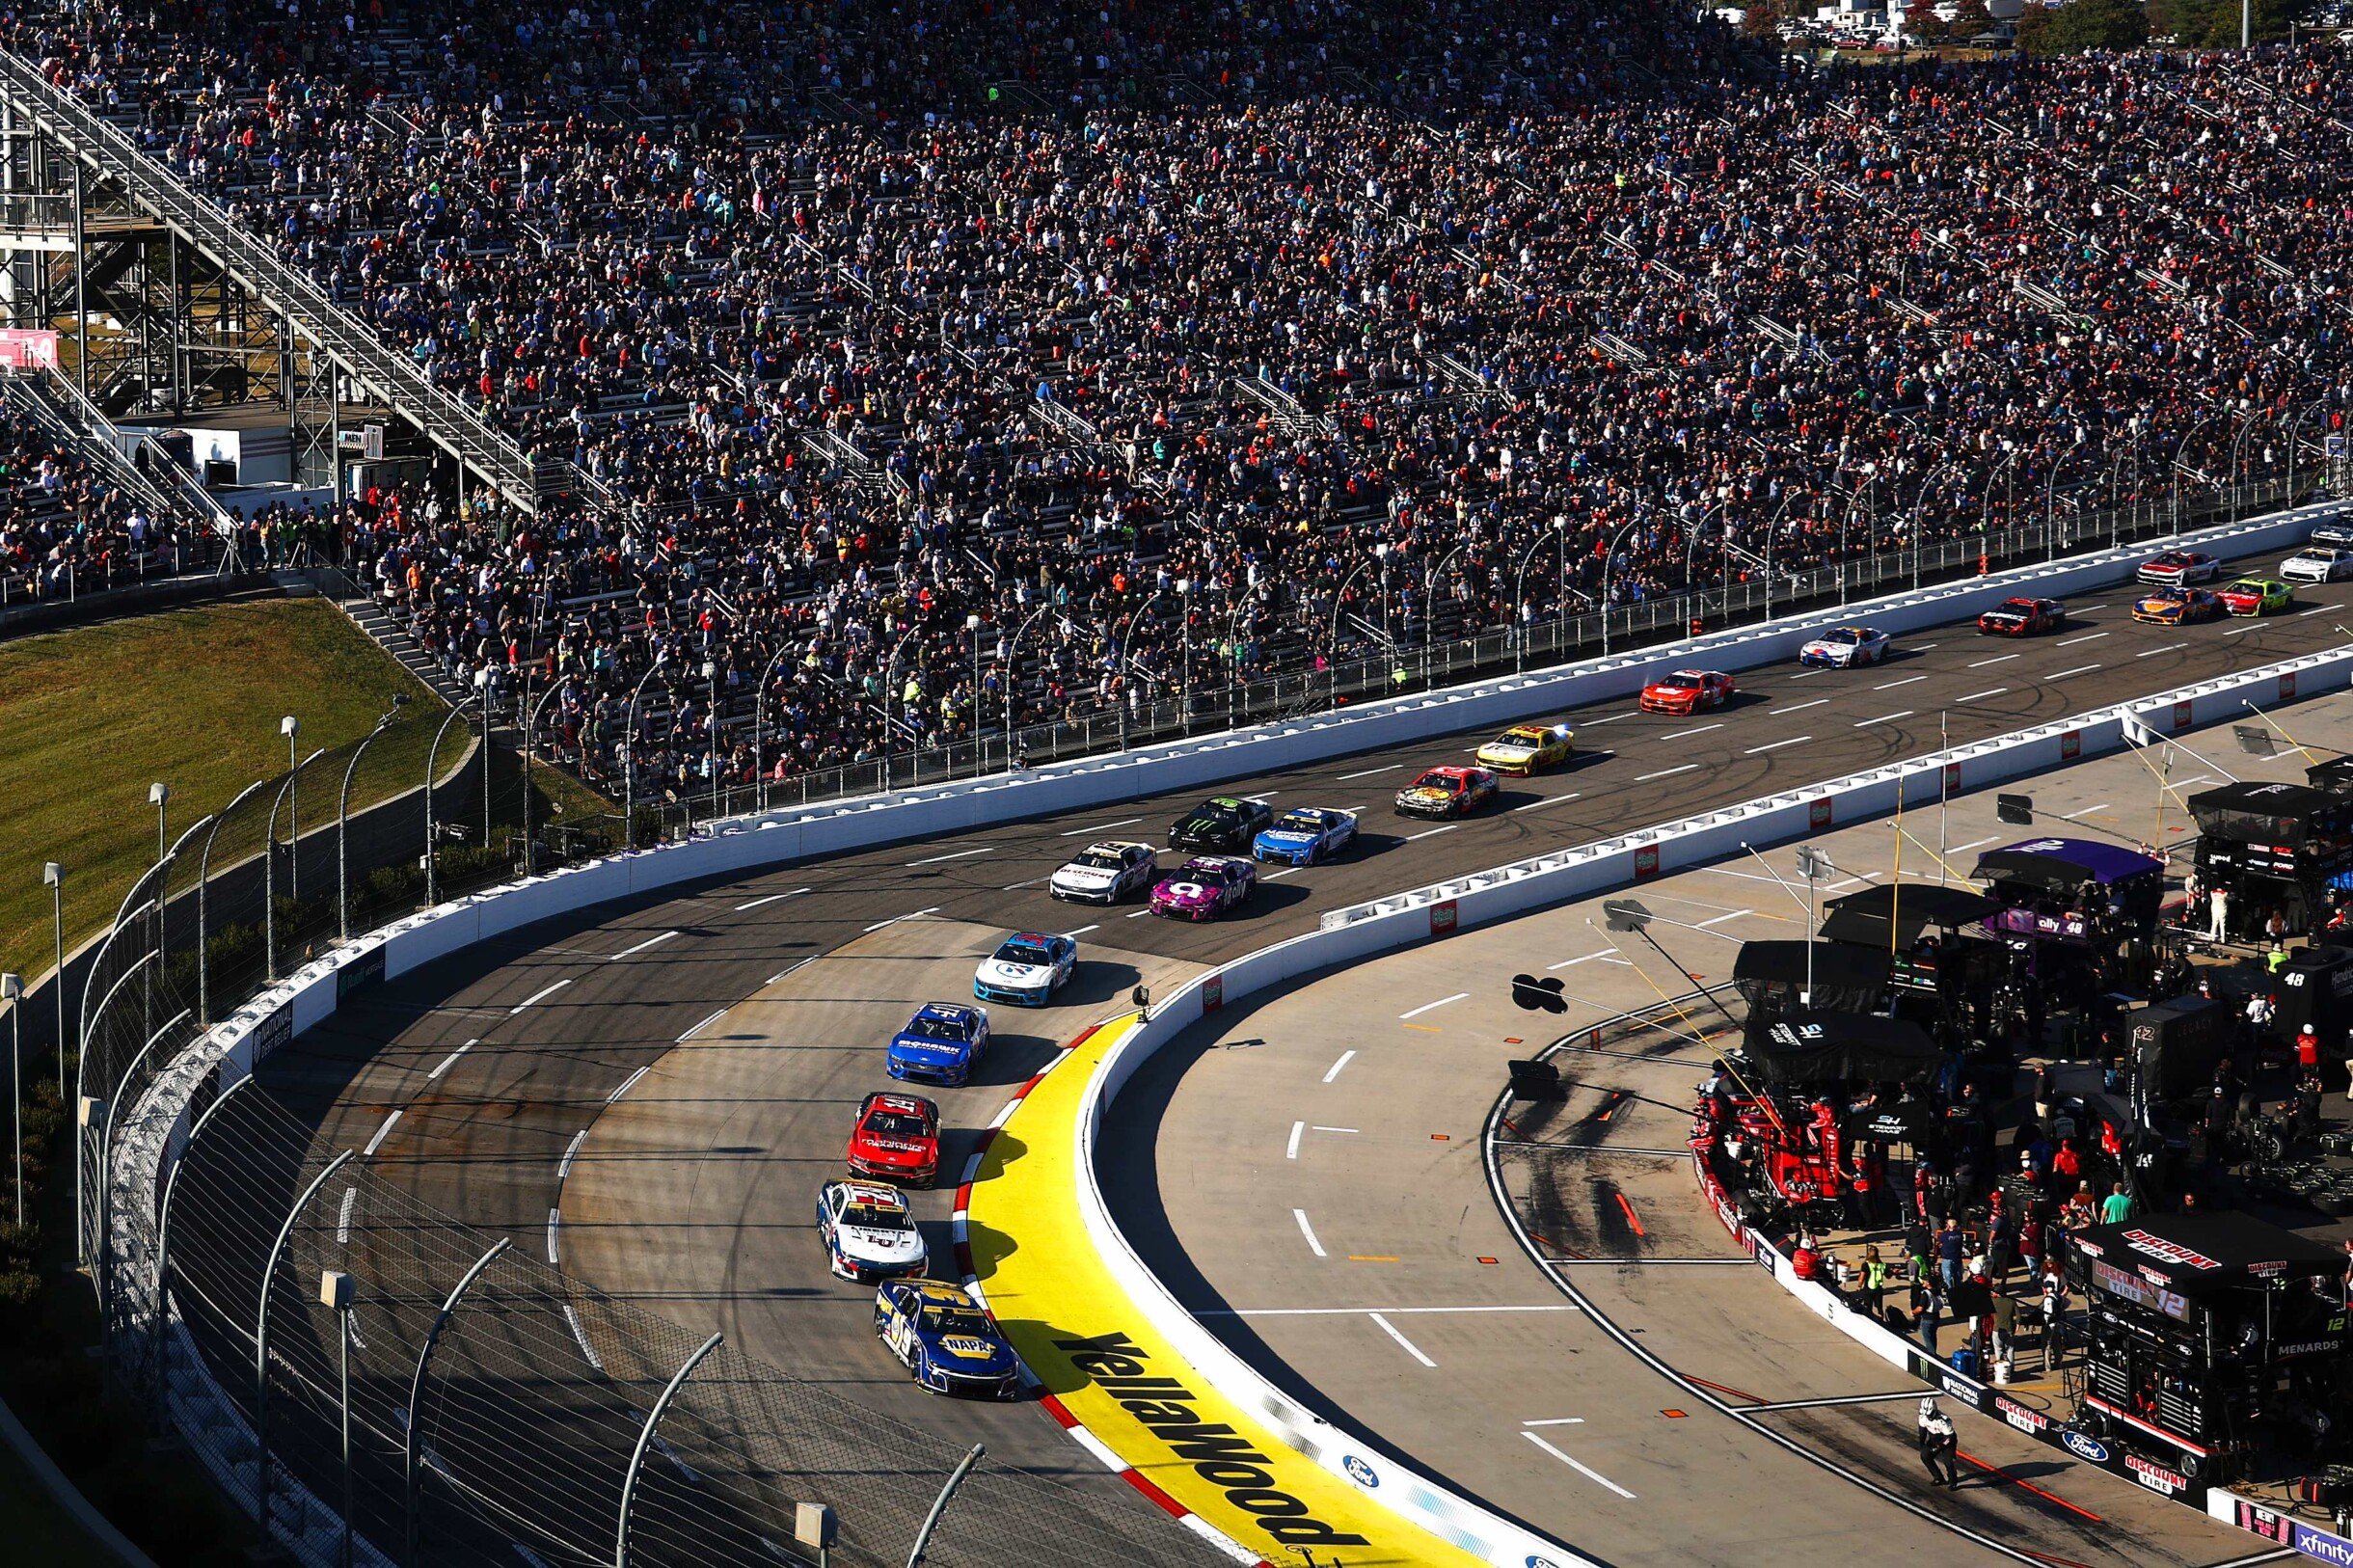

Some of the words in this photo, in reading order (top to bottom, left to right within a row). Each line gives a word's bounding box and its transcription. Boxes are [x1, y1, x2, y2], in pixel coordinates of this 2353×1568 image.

[344, 433, 362, 444] MEN
[2273, 861, 2294, 870] FORD
[2039, 918, 2060, 933] ally
[2067, 921, 2083, 933] 48
[2285, 972, 2305, 987] 48
[261, 1006, 292, 1041] NATIONAL
[2135, 1025, 2155, 1041] 42
[898, 1040, 961, 1053] MOHAWK
[2122, 1229, 2223, 1270] DISCOUNT
[2135, 1243, 2177, 1261] TIRE
[2248, 1260, 2287, 1273] DISCOUNT
[2096, 1261, 2155, 1297] DISCOUNT
[2112, 1281, 2139, 1300] TIRE
[2157, 1285, 2186, 1318] 12
[2327, 1318, 2345, 1331] 12
[901, 1325, 912, 1356] 9
[946, 1338, 989, 1352] NAPA
[2278, 1339, 2339, 1356] MENARDS
[1950, 1379, 1980, 1400] NATIONAL
[1950, 1388, 1963, 1399] DEBT
[1962, 1394, 1979, 1406] RELIEF
[1995, 1396, 2048, 1430] DISCOUNT
[2010, 1414, 2032, 1430] TIRE
[1051, 1332, 1372, 1546] YellaWood
[2069, 1434, 2099, 1458] Ford
[1347, 1456, 1373, 1487] Ford
[2124, 1454, 2187, 1491] DISCOUNT
[2142, 1474, 2169, 1491] TIRE
[2300, 1533, 2353, 1566] xfinity
